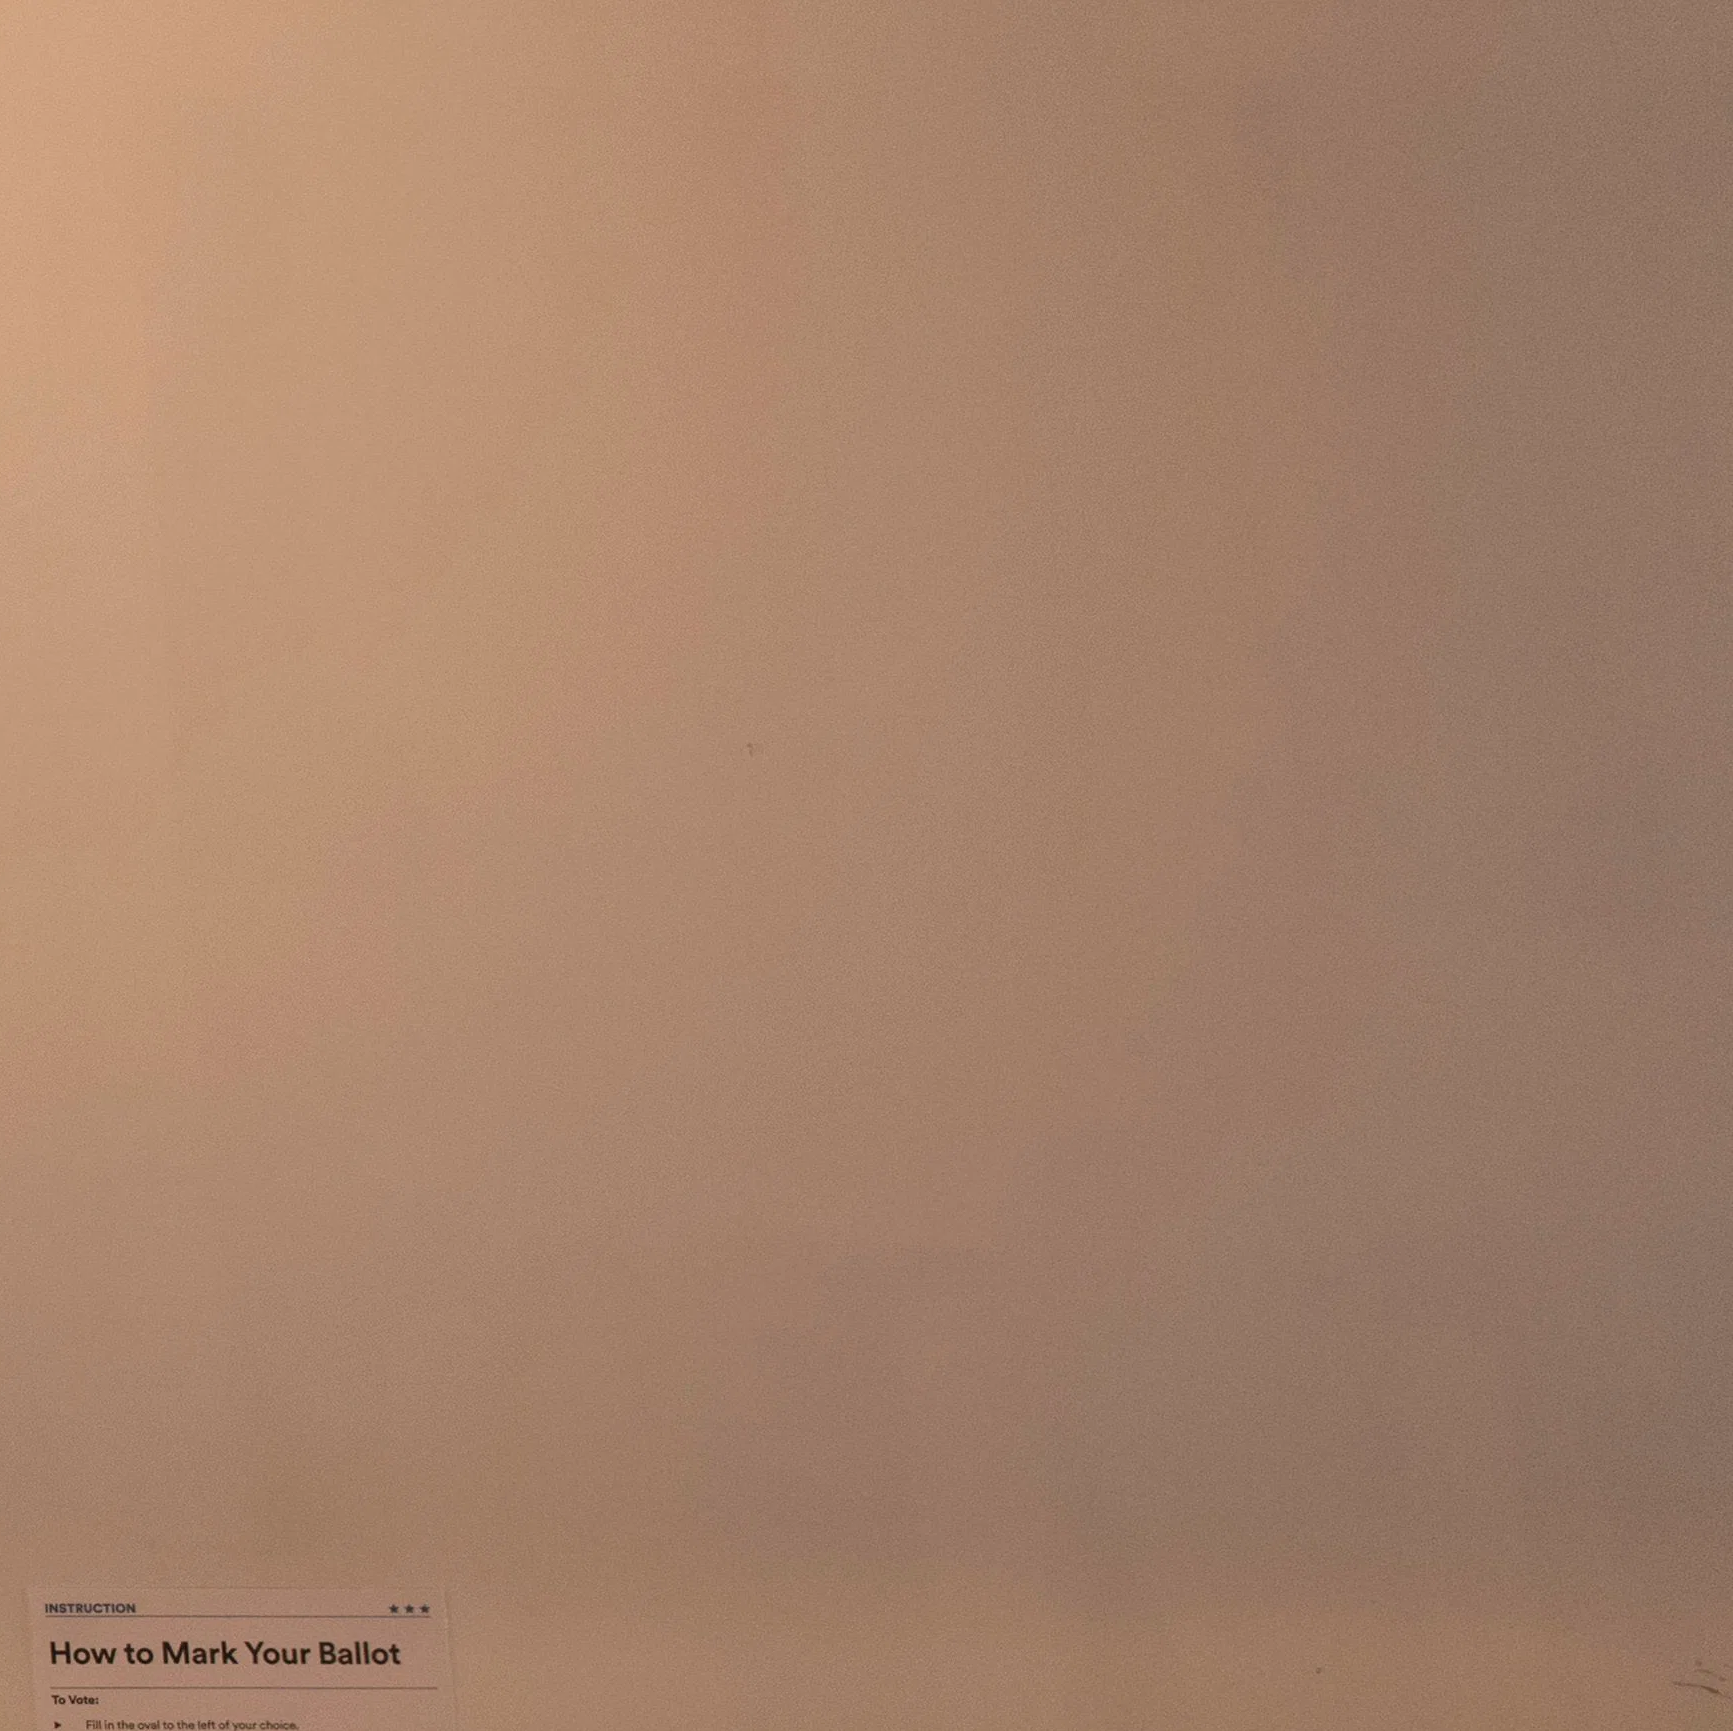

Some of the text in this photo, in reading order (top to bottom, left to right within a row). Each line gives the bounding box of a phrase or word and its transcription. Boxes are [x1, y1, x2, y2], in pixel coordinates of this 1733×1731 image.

[45, 1604, 136, 1614] INSTRUCTION
[50, 1642, 400, 1665] How to Mark Your Ballot
[52, 1696, 98, 1705] To Vote:
[86, 1721, 102, 1730] Fill
[105, 1721, 114, 1730] in
[117, 1721, 134, 1730] the
[138, 1721, 159, 1730] oval
[162, 1721, 174, 1730] to
[177, 1721, 194, 1730] the
[198, 1721, 215, 1730] left
[218, 1721, 230, 1730] of
[260, 1721, 299, 1730] choice.
